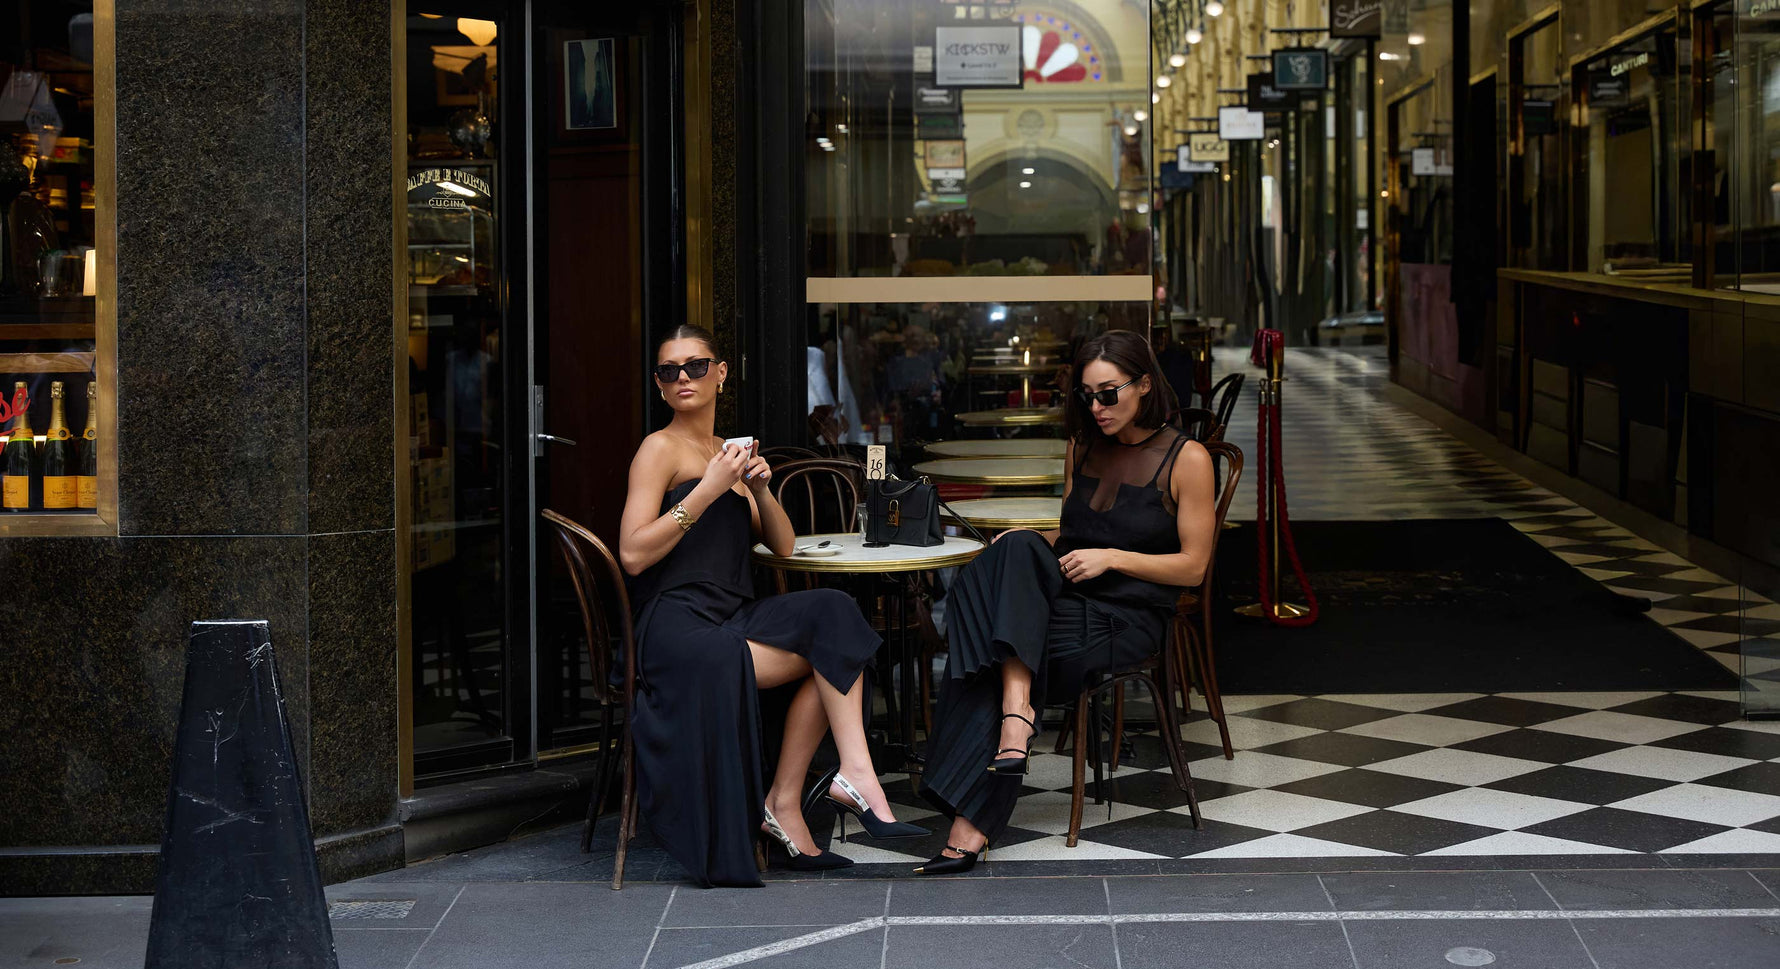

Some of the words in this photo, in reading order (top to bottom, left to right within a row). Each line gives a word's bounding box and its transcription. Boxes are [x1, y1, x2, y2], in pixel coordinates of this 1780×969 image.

[1609, 52, 1649, 77] CANTURI
[1194, 141, 1225, 152] UGG
[442, 168, 452, 181] E
[453, 169, 491, 198] TORTA
[428, 199, 467, 208] CUCINA
[870, 459, 883, 470] 16
